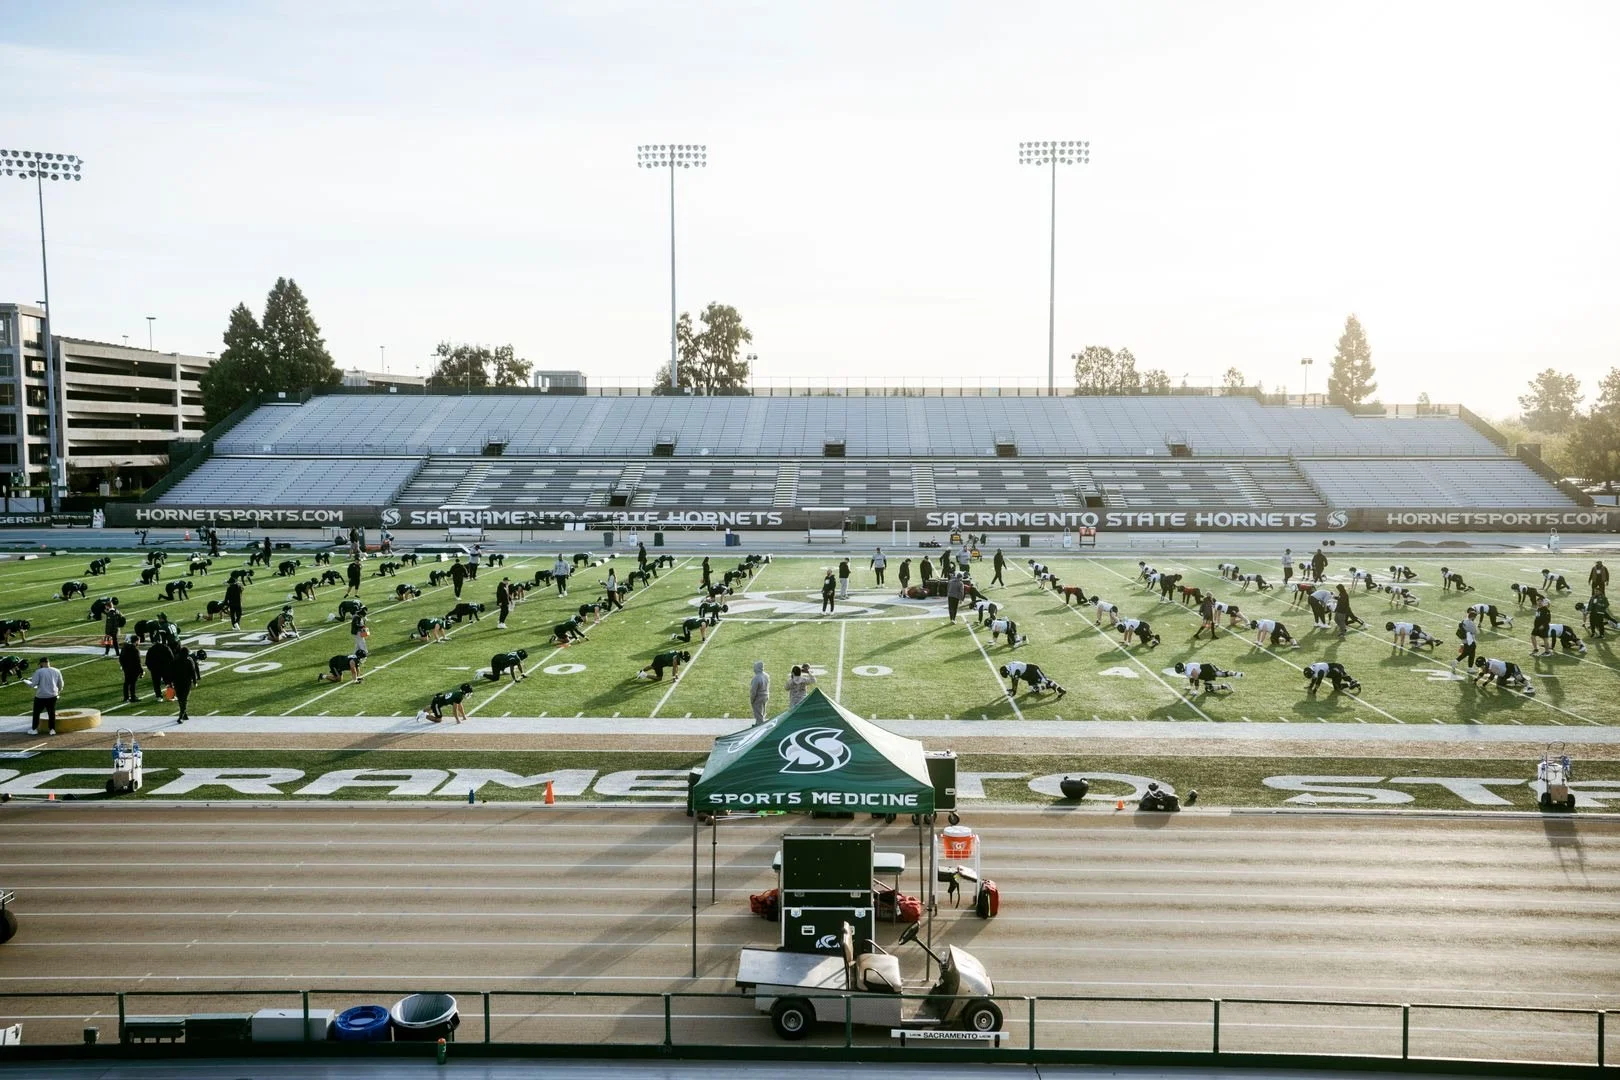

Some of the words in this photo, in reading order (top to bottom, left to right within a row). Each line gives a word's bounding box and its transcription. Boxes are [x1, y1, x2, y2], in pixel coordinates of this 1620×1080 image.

[136, 508, 344, 522] HORNETSPORTS.COM
[667, 511, 783, 525] HORNETS
[926, 511, 1099, 527] SACRAMENTO
[1105, 512, 1187, 526] STATE
[1195, 512, 1317, 527] HORNETS
[1386, 512, 1608, 526] HORNETSPORTS.COM
[708, 792, 802, 805] SPORTS
[811, 791, 918, 806] MEDICINE
[923, 1031, 978, 1039] SACRAMENTO
